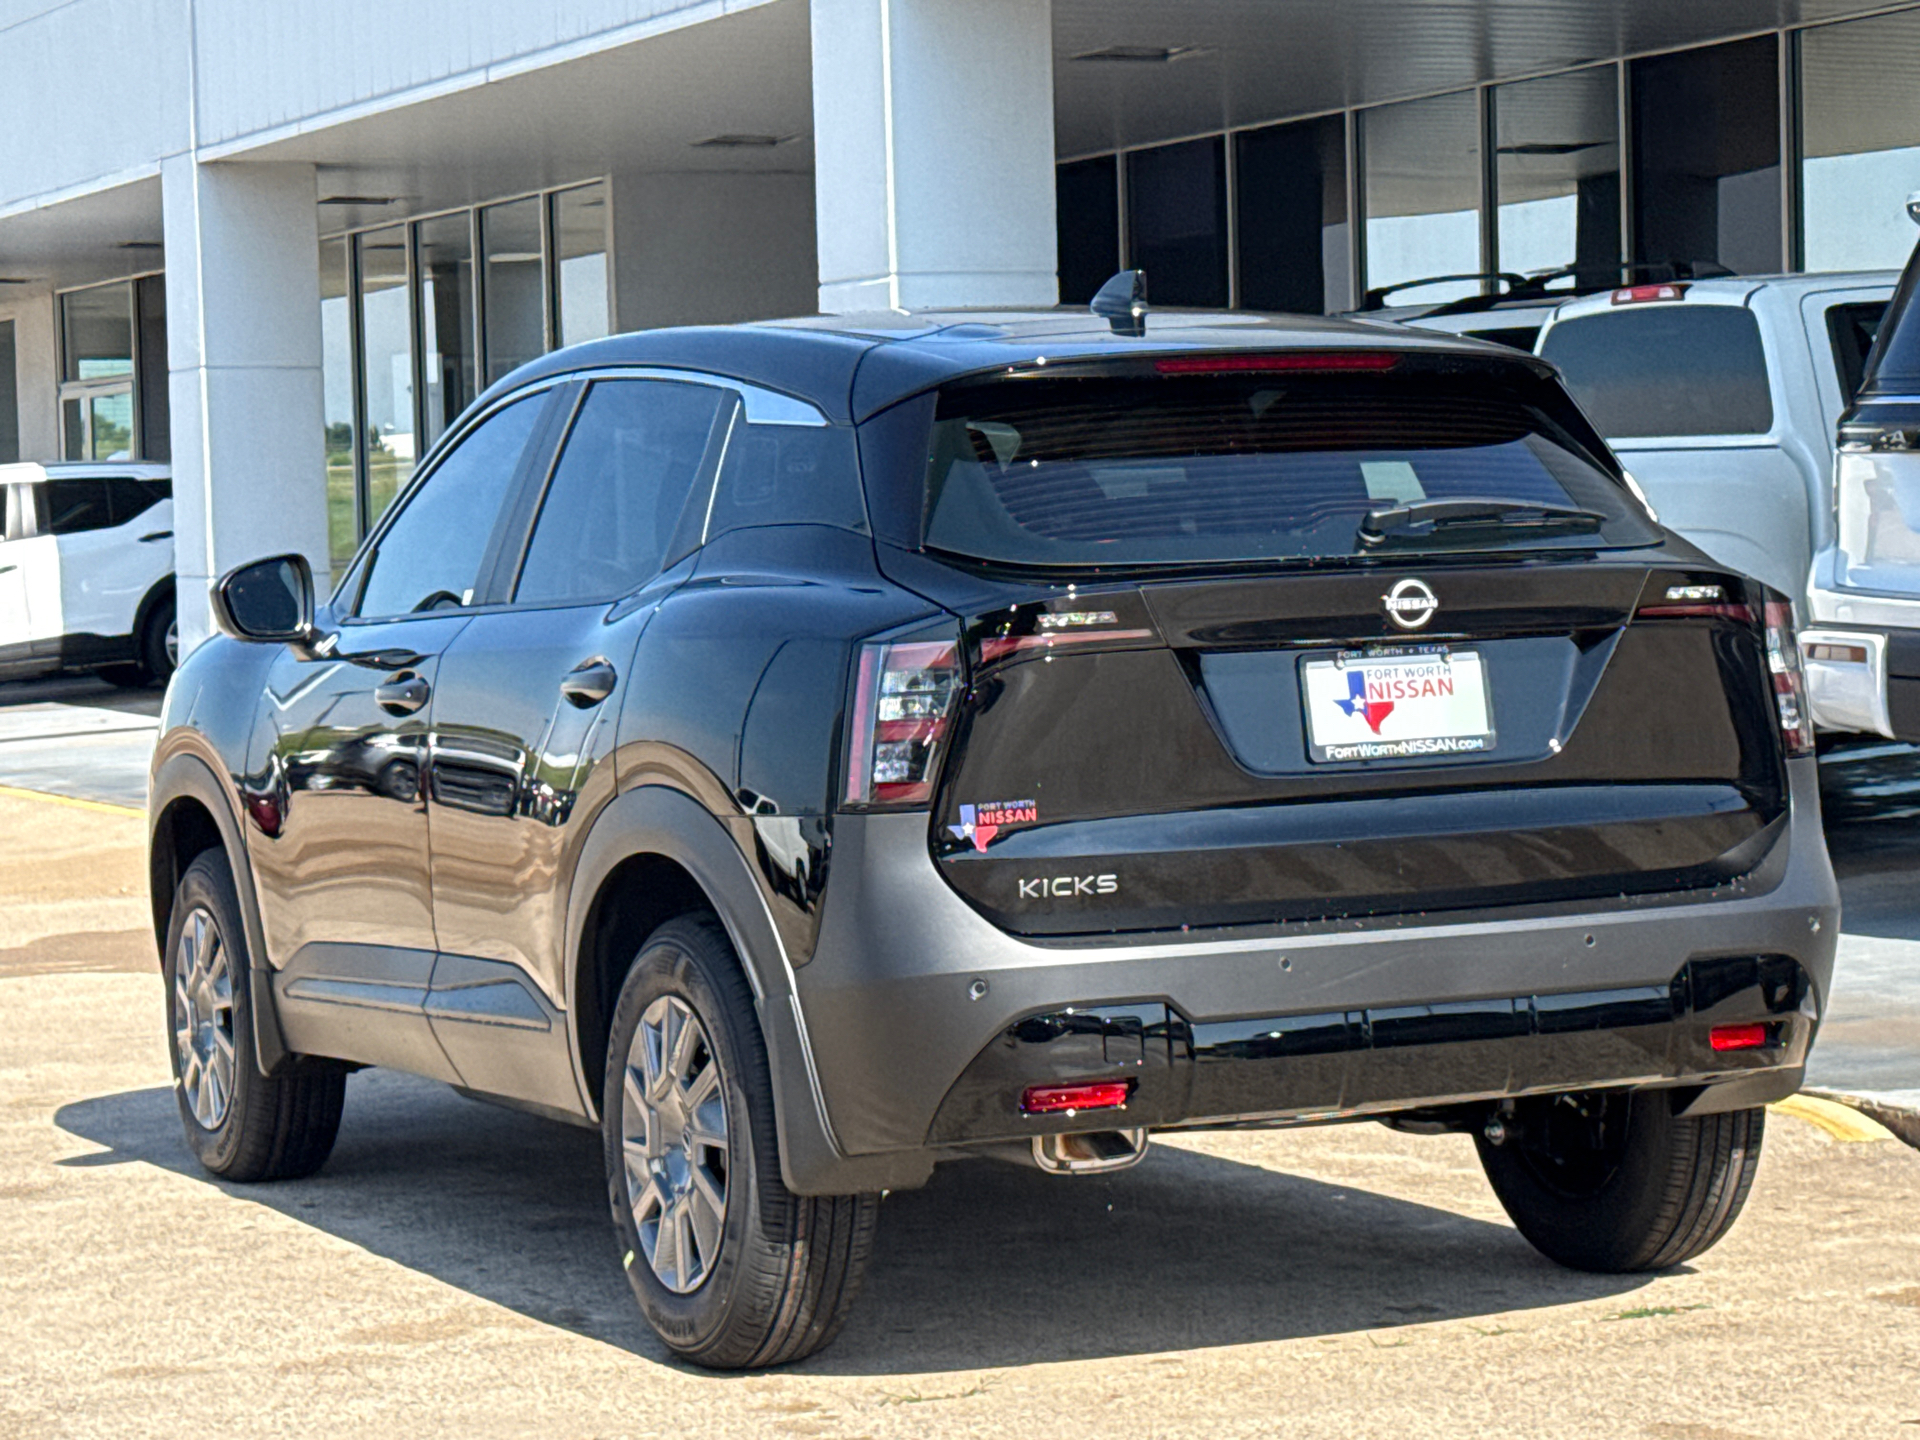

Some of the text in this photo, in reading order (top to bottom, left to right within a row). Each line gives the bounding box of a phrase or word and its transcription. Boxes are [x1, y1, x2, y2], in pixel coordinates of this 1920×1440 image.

[1386, 598, 1438, 610] NISSAN
[1337, 645, 1449, 659] FORT WORTH TEXAS
[1366, 665, 1451, 680] FORT WORTH
[1369, 677, 1454, 700] NISSAN
[978, 799, 1036, 810] FORT WORTH
[978, 808, 1037, 825] NISSAN
[1018, 874, 1118, 899] KICKS
